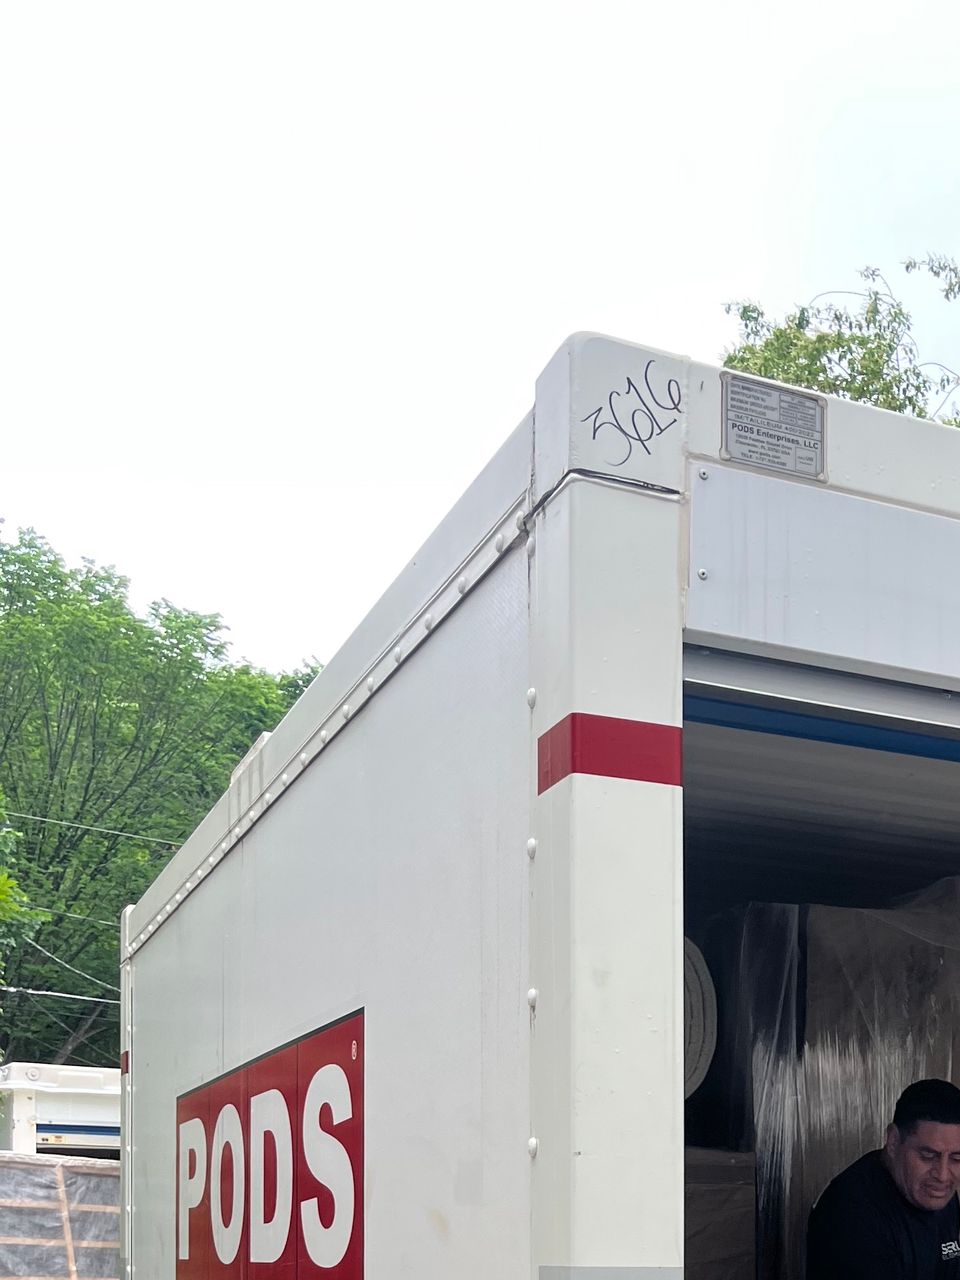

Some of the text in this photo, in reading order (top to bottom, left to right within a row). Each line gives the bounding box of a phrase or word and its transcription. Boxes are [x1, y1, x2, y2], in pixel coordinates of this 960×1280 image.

[731, 422, 755, 435] PODS
[803, 440, 819, 450] LLC
[178, 1062, 356, 1269] PODS
